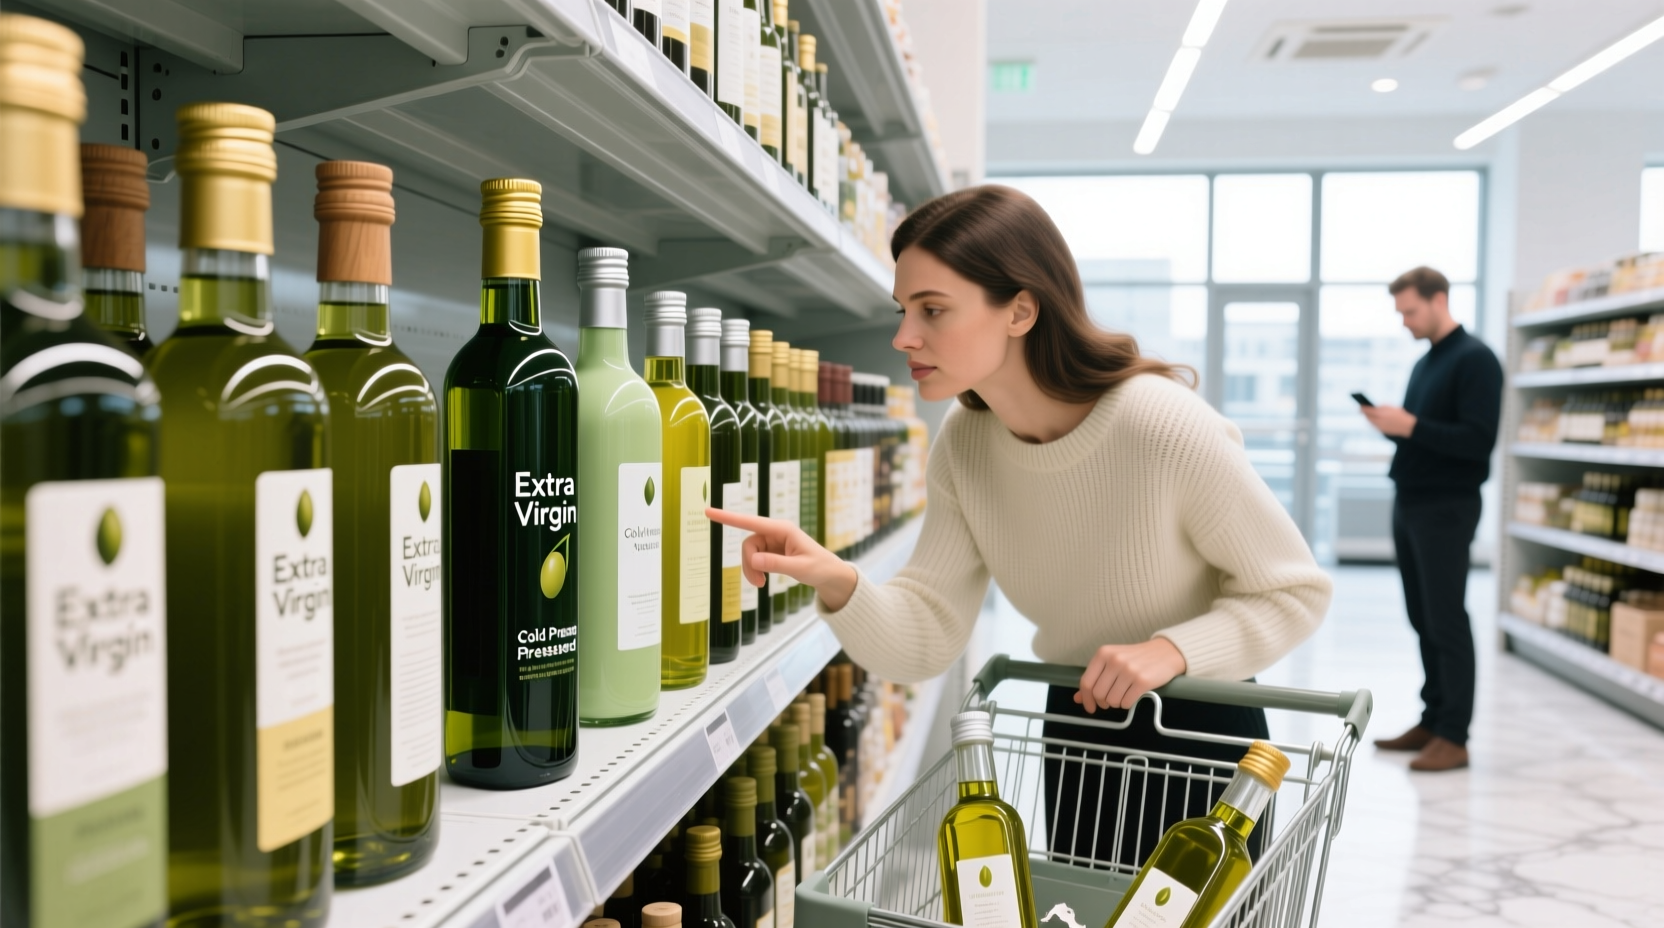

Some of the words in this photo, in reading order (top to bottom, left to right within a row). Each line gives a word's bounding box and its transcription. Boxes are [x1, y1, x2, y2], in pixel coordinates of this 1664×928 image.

[515, 471, 575, 498] Extra
[514, 499, 577, 532] Virgin
[403, 536, 441, 560] Extra
[274, 553, 327, 583] Extra
[55, 584, 149, 628] Extra
[273, 583, 333, 622] Virgin
[55, 622, 154, 676] Virgin
[517, 627, 546, 644] Cold
